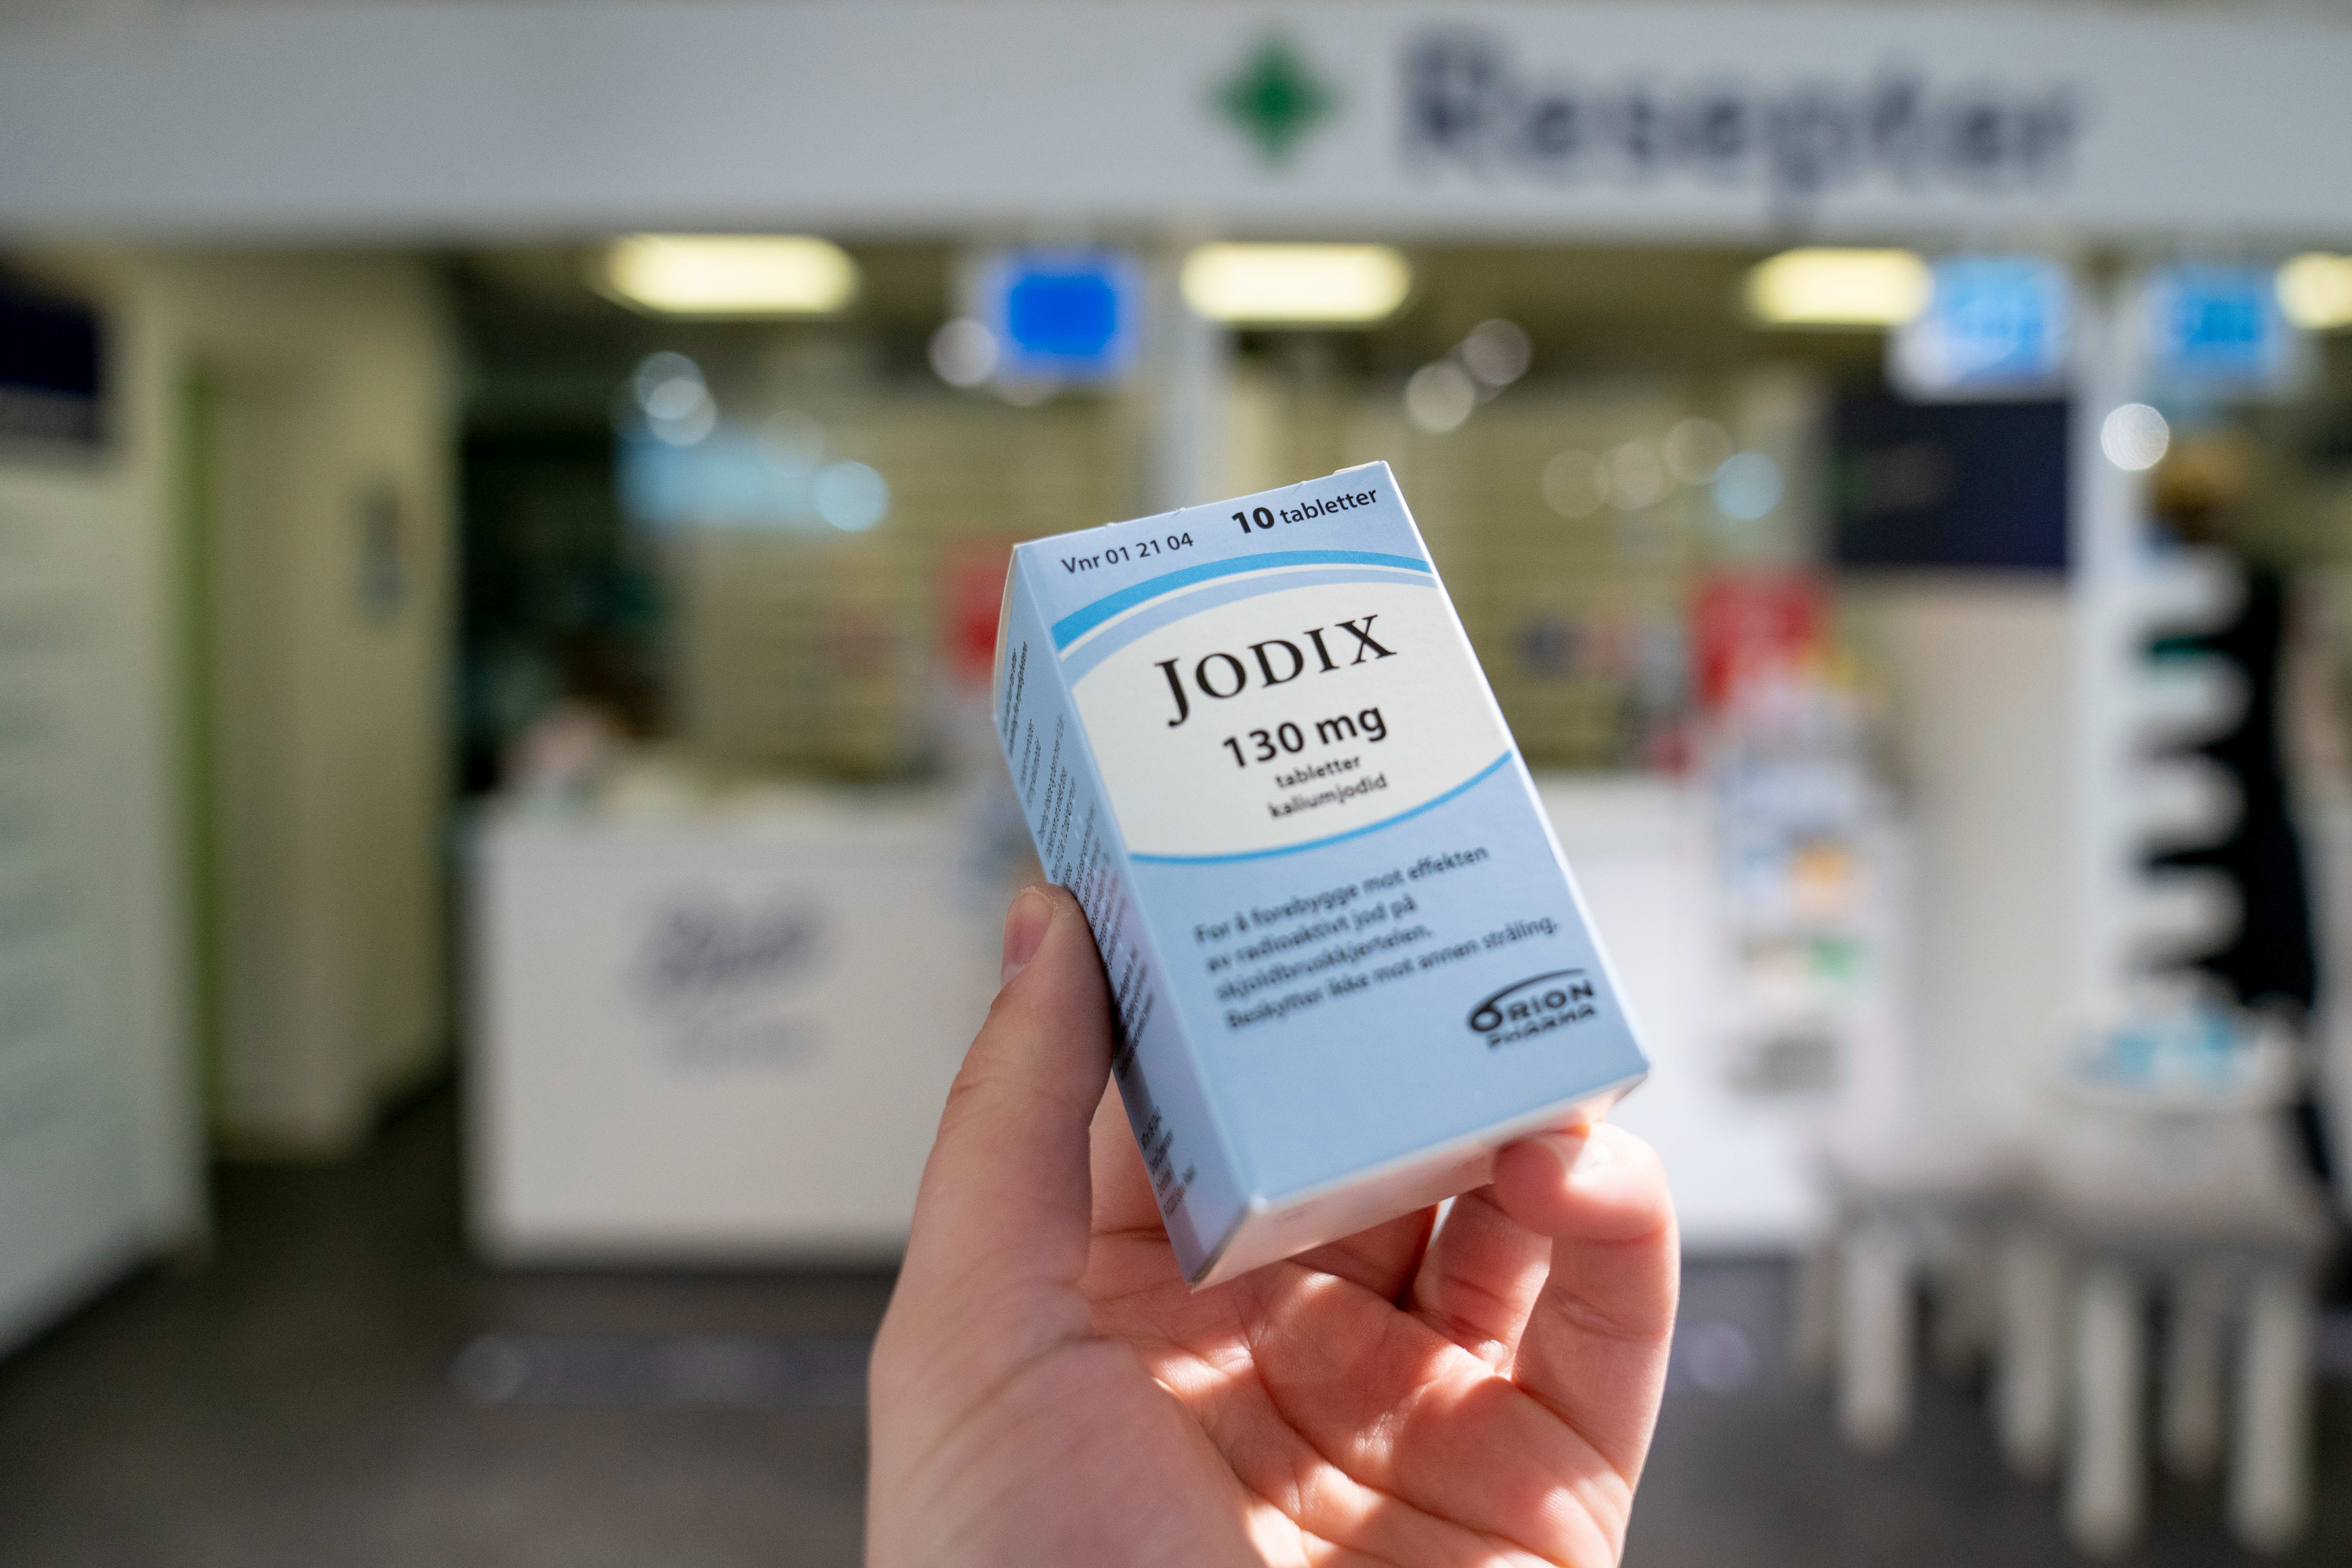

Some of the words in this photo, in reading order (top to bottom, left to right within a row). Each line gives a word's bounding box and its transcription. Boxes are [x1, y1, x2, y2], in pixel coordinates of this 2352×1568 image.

[1399, 29, 2090, 231] Resepter
[1232, 507, 1275, 534] 10
[1280, 487, 1378, 524] tabletter
[1061, 554, 1100, 575] Vnr
[1106, 546, 1130, 565] 01
[1137, 539, 1161, 560] 21
[1167, 532, 1194, 551] 04
[1155, 614, 1397, 727] JODIX
[1223, 722, 1305, 768] 130
[1315, 706, 1387, 743] mg
[1268, 772, 1388, 819] kaliumjodid
[1275, 756, 1361, 788] tabletter
[1195, 920, 1231, 944] For
[1236, 910, 1249, 932] å
[1252, 882, 1359, 927] forebygge
[1362, 873, 1405, 895] mot
[1407, 845, 1490, 881] effekten
[1206, 955, 1231, 973] av
[1237, 918, 1351, 962] radioaktivt
[1353, 905, 1387, 933] jod
[1392, 892, 1418, 920] på
[1328, 974, 1372, 998] ikke
[1372, 961, 1416, 985] mot
[1418, 942, 1477, 970] annen
[1469, 969, 1596, 1032] ORION
